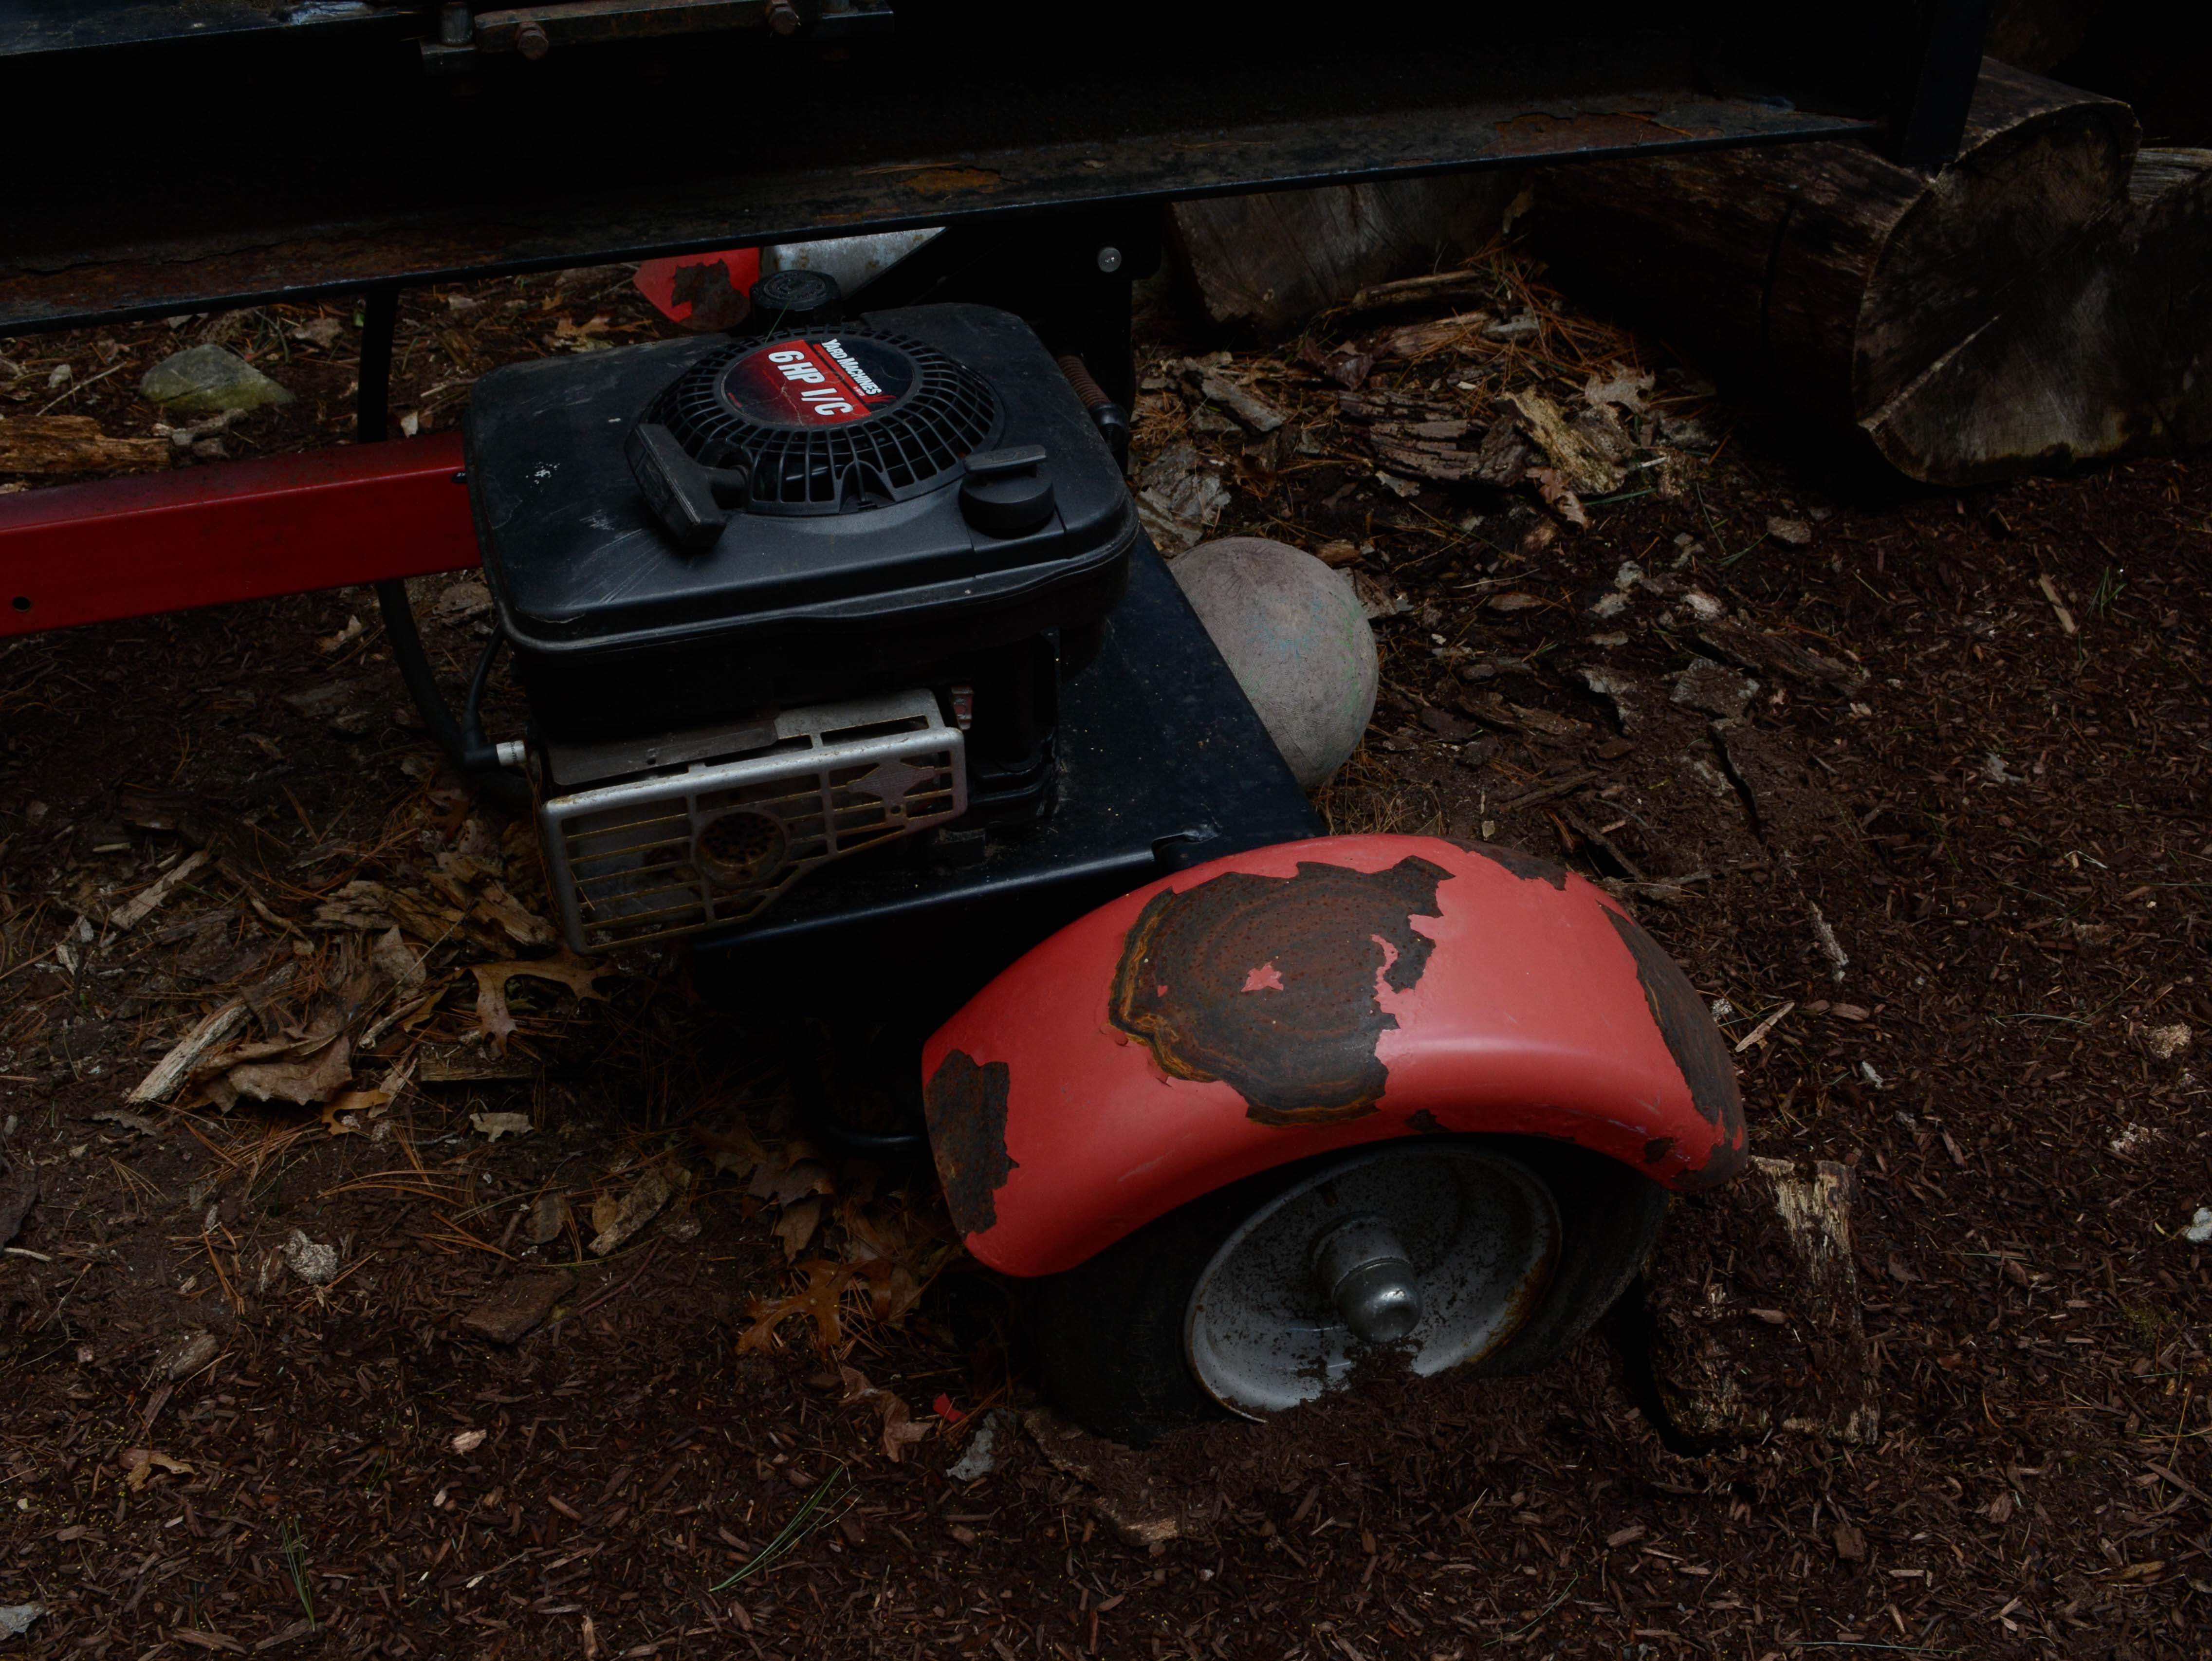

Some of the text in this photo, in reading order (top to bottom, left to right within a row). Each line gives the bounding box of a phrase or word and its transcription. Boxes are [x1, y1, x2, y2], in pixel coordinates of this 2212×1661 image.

[821, 338, 882, 395] YARD MACHINES
[800, 388, 853, 415] I/C
